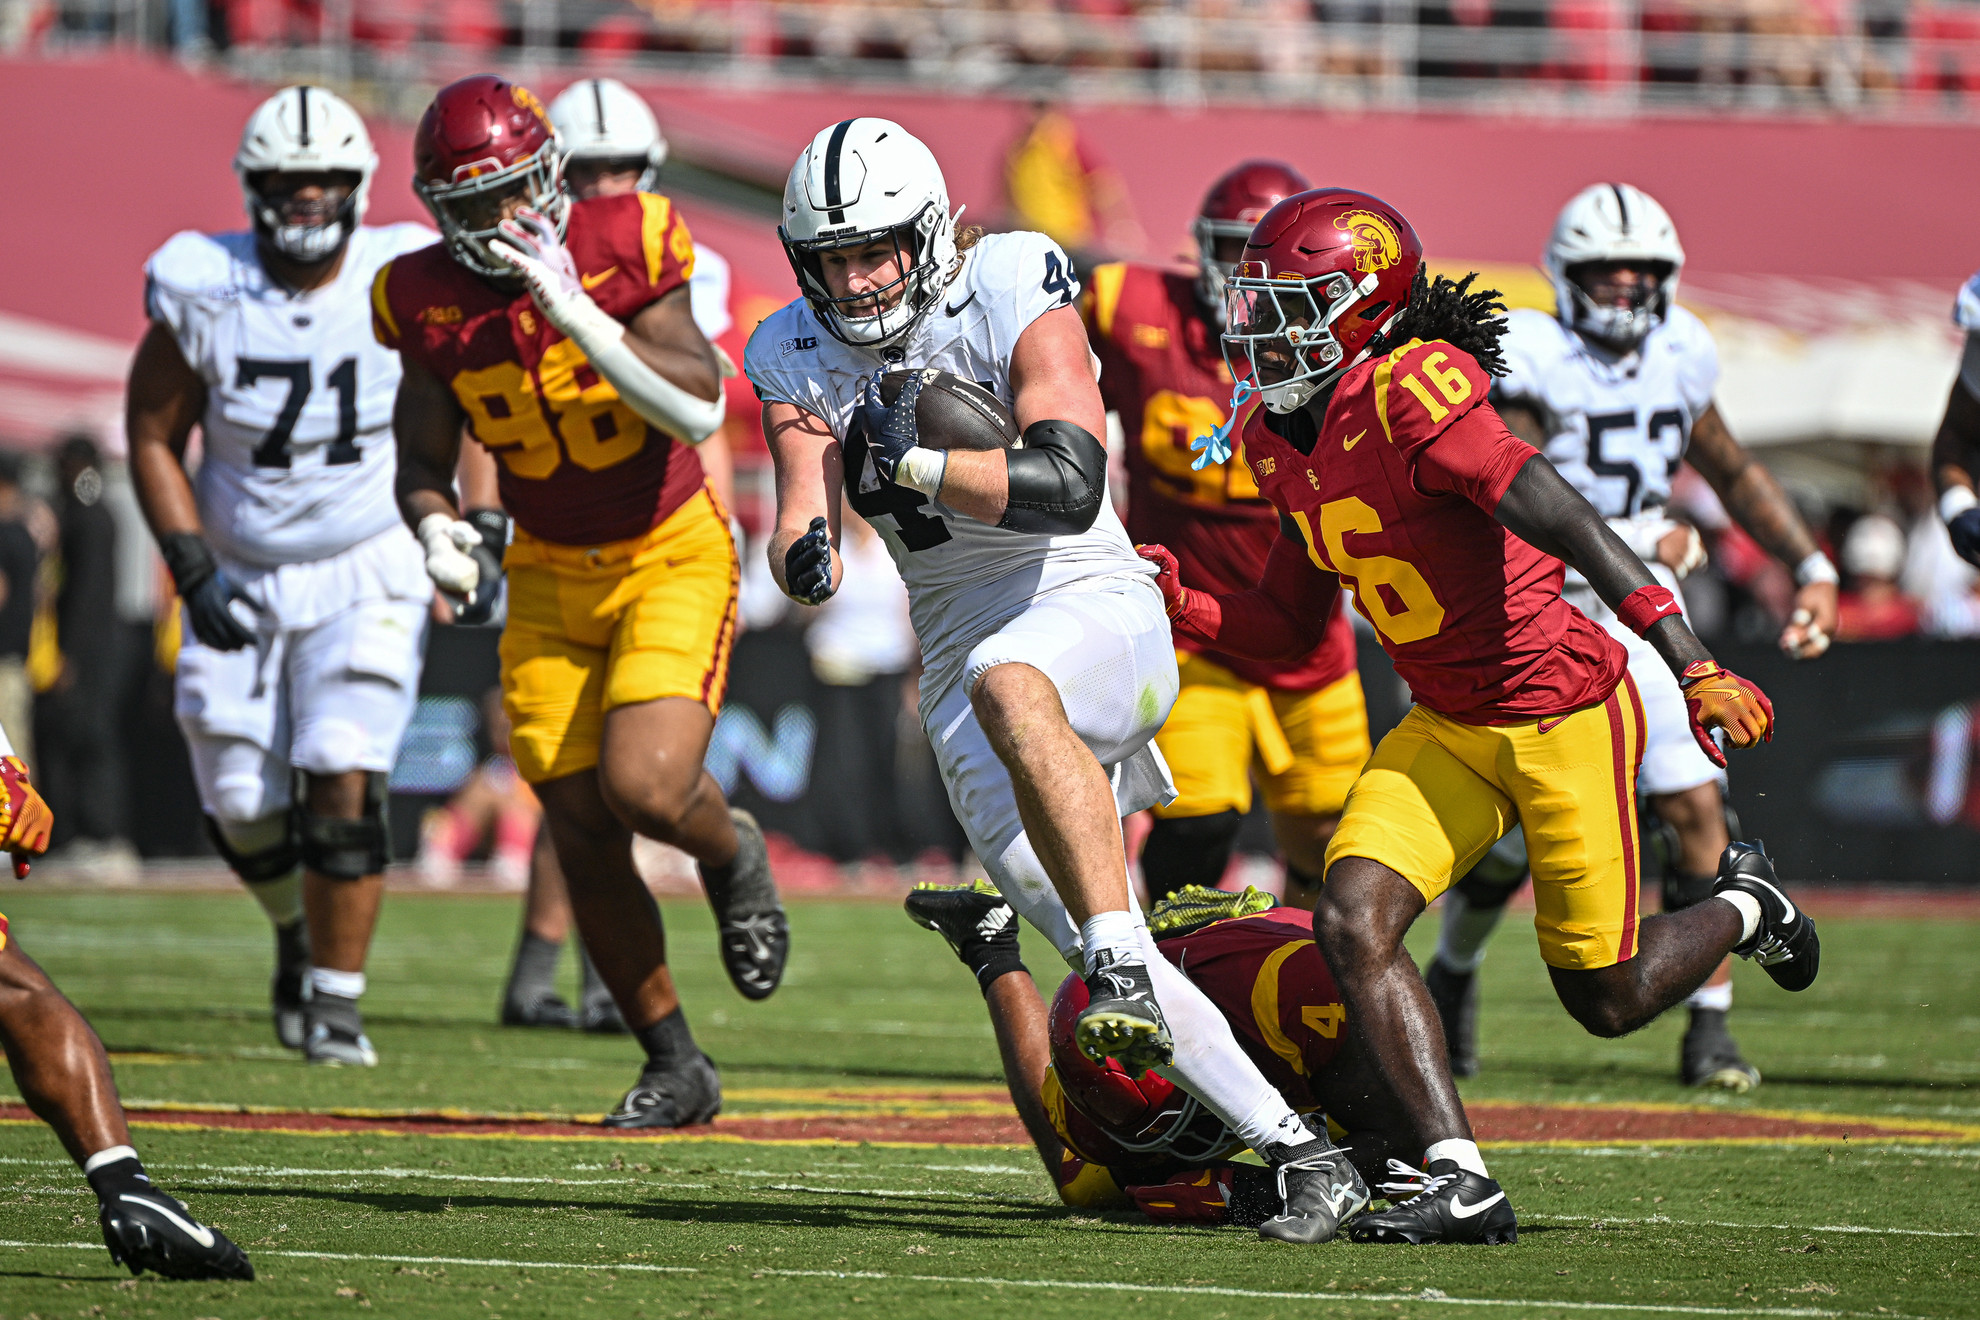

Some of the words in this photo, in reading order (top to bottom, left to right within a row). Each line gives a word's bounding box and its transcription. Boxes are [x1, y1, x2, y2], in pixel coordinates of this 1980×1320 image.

[234, 356, 363, 469] 71
[452, 338, 647, 480] 98
[1399, 351, 1472, 425] 16
[1307, 468, 1320, 491] SC
[1290, 496, 1445, 645] 16
[1301, 1002, 1346, 1039] 4
